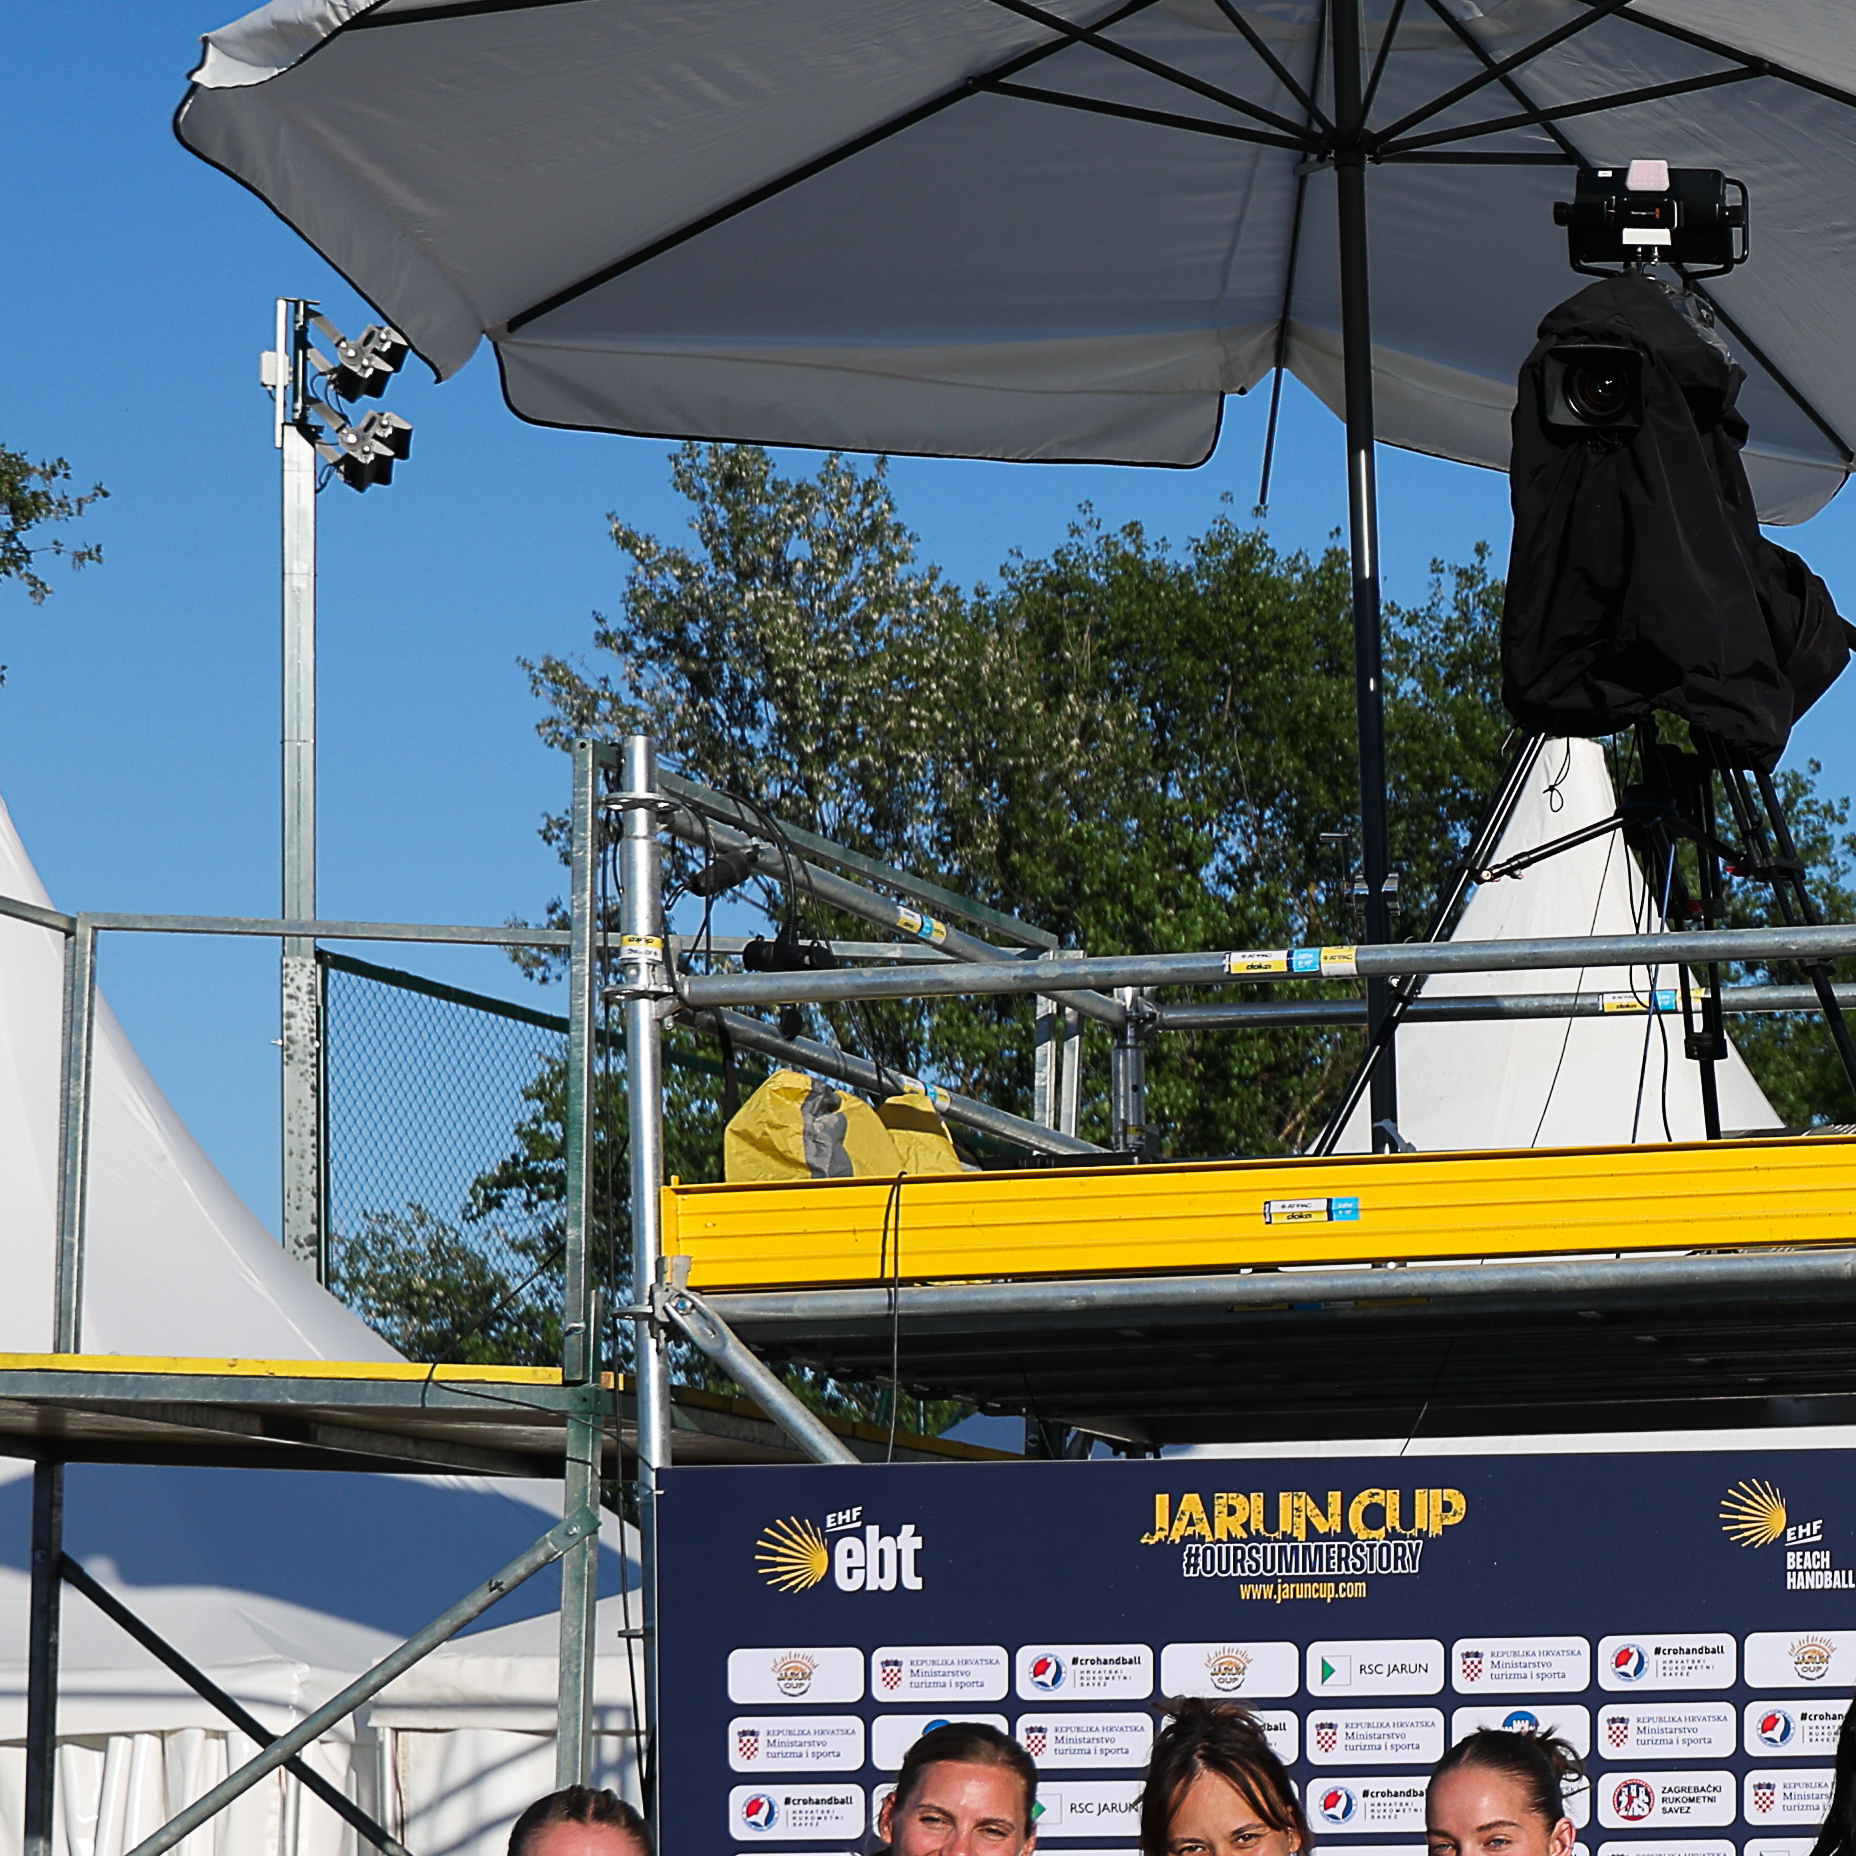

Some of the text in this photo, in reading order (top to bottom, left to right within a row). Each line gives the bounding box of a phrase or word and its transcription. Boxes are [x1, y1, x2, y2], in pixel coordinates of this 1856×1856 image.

[1287, 1212, 1312, 1220] doka
[826, 1506, 862, 1528] EHF
[1140, 1488, 1466, 1544] JARUN CUP
[1787, 1520, 1822, 1541] EHF
[834, 1524, 922, 1592] ebt
[1183, 1540, 1423, 1577] #OURSUMMERSTORY
[1787, 1551, 1830, 1569] BEACH
[1787, 1570, 1855, 1589] HANDBALL
[1240, 1580, 1366, 1603] www.jaruncup.com
[1654, 1646, 1724, 1655] #crohandball
[1072, 1657, 1141, 1666] #crohandball
[1491, 1660, 1552, 1668] Ministarstvo
[1359, 1663, 1428, 1676] RSC JARUN
[1491, 1671, 1528, 1679] turizma
[1537, 1671, 1566, 1680] sporta
[1636, 1726, 1698, 1734] Ministarstvo
[1055, 1736, 1115, 1744] Ministarstvo
[1636, 1737, 1673, 1745] turizma
[1682, 1737, 1712, 1746] sporta
[1055, 1747, 1091, 1755] turizma
[1100, 1747, 1129, 1756] sporta
[1662, 1785, 1721, 1793] ZAGREBAČKI
[784, 1796, 853, 1805] #crohandball
[1662, 1796, 1716, 1804] RUKOMETNI
[1070, 1802, 1141, 1816] RSC JARUN
[1662, 1806, 1691, 1814] SAVEZ
